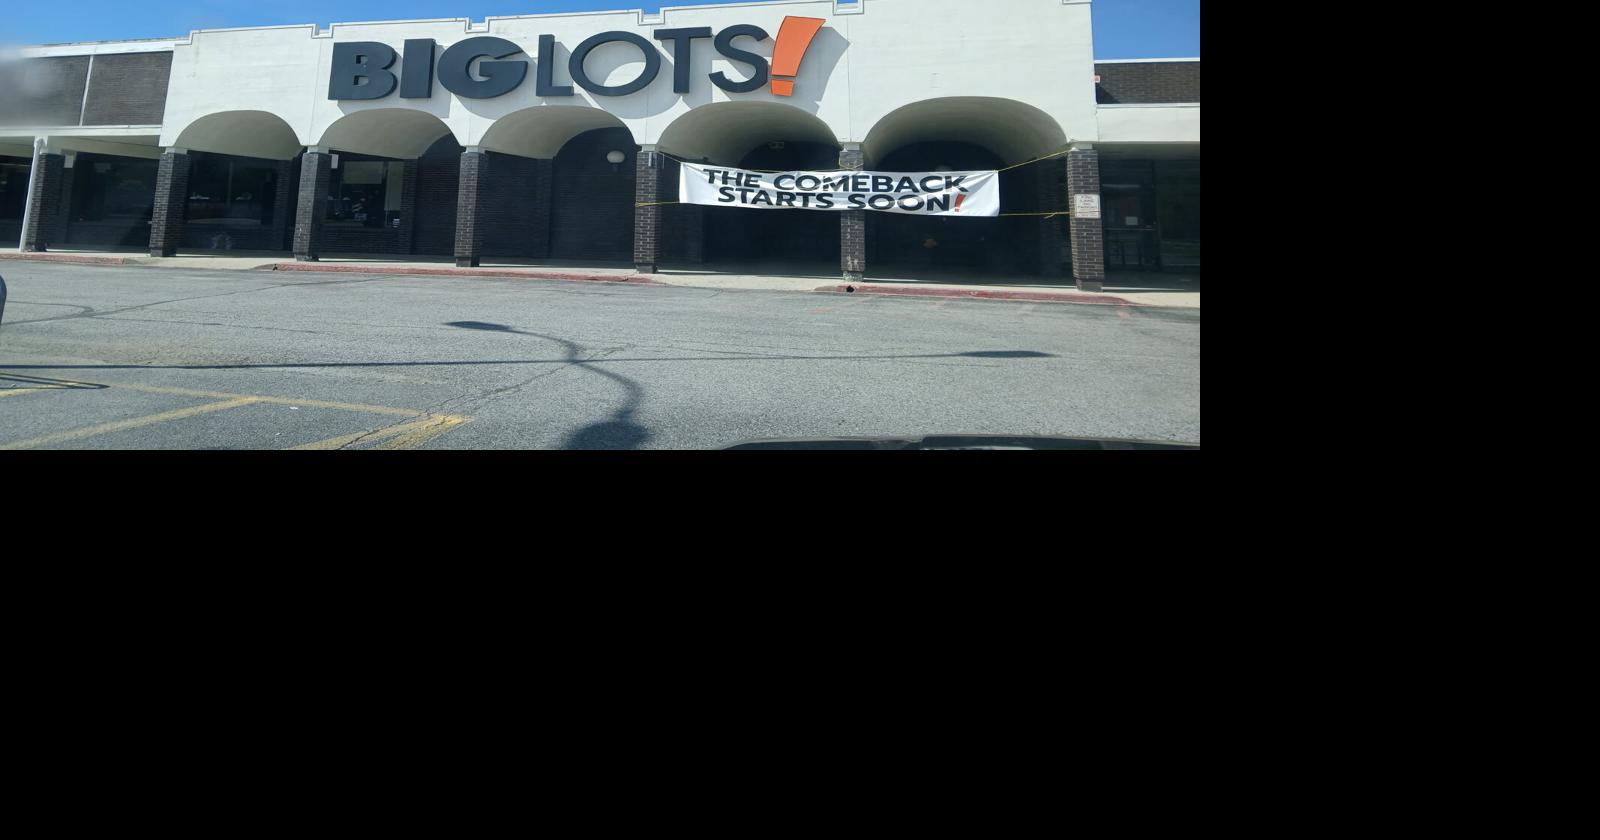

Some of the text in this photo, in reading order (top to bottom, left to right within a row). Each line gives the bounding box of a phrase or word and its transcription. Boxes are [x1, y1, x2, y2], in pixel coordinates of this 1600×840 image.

[328, 35, 528, 100] BIG
[703, 168, 969, 193] THE COMEBACK
[717, 187, 966, 213] STARTS SOON!
